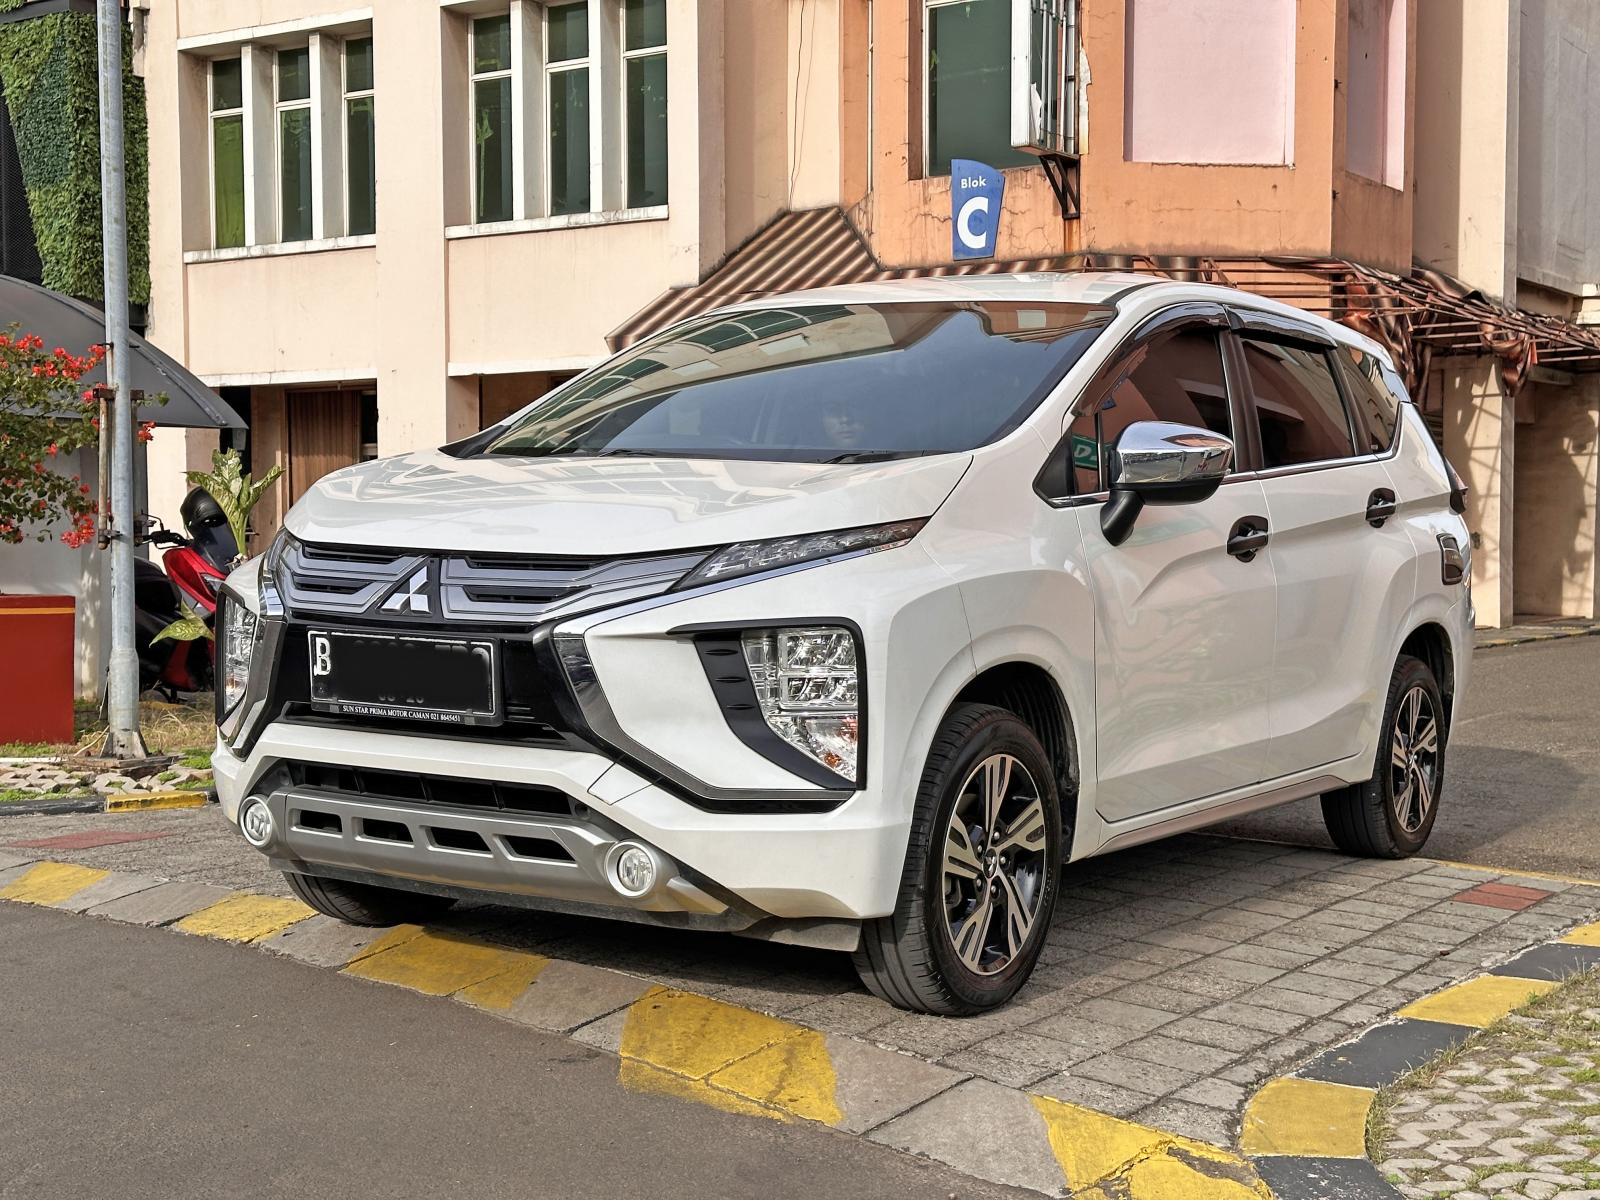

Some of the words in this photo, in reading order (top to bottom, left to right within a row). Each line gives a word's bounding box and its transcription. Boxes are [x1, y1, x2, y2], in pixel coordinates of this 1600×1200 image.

[961, 176, 987, 189] Blok
[957, 196, 988, 249] C
[313, 637, 331, 676] B
[342, 704, 354, 712] SUN
[355, 706, 369, 714] STAR
[369, 707, 387, 716] PRIMA
[388, 709, 408, 718] MOTOR
[408, 711, 430, 720] CAMAN
[430, 713, 439, 721] 021
